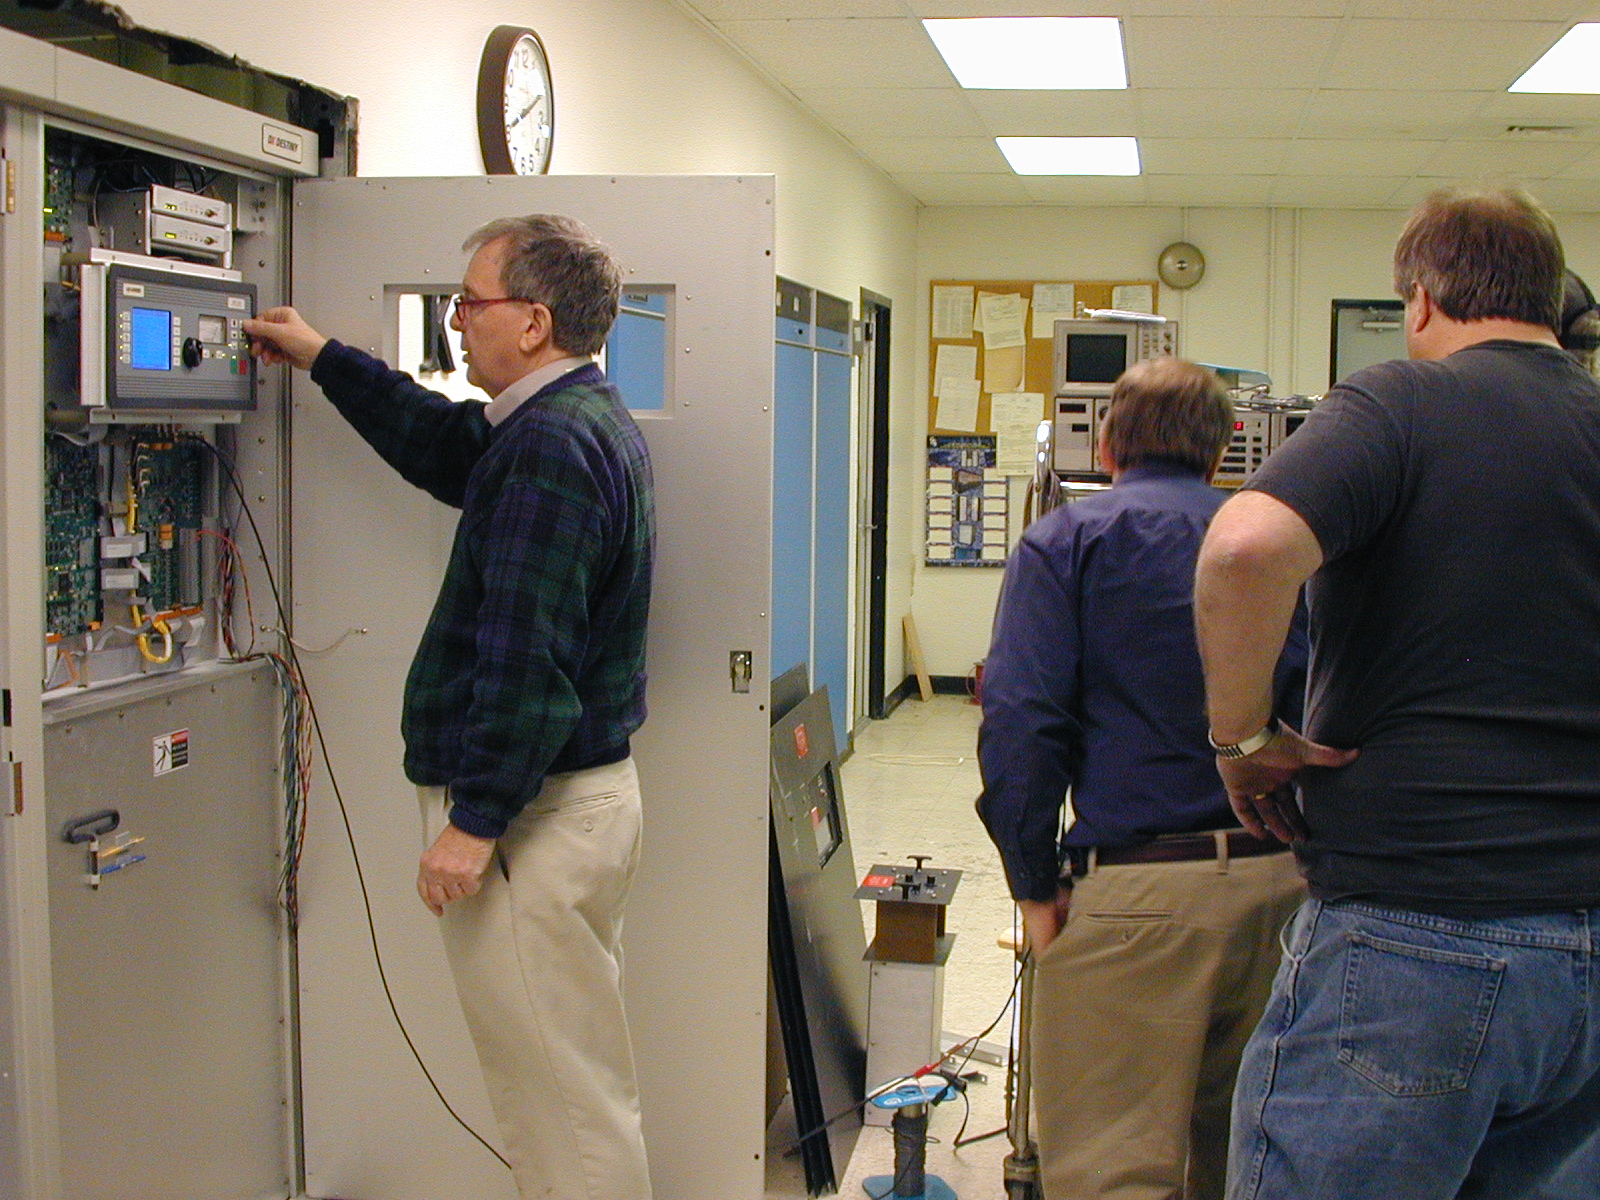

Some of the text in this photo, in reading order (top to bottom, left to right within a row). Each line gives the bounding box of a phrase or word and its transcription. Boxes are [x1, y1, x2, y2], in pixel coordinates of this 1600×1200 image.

[276, 138, 298, 151] DESTINY
[535, 137, 540, 156] 4
[513, 146, 518, 164] 7
[529, 153, 534, 172] 5
[521, 156, 526, 175] 6
